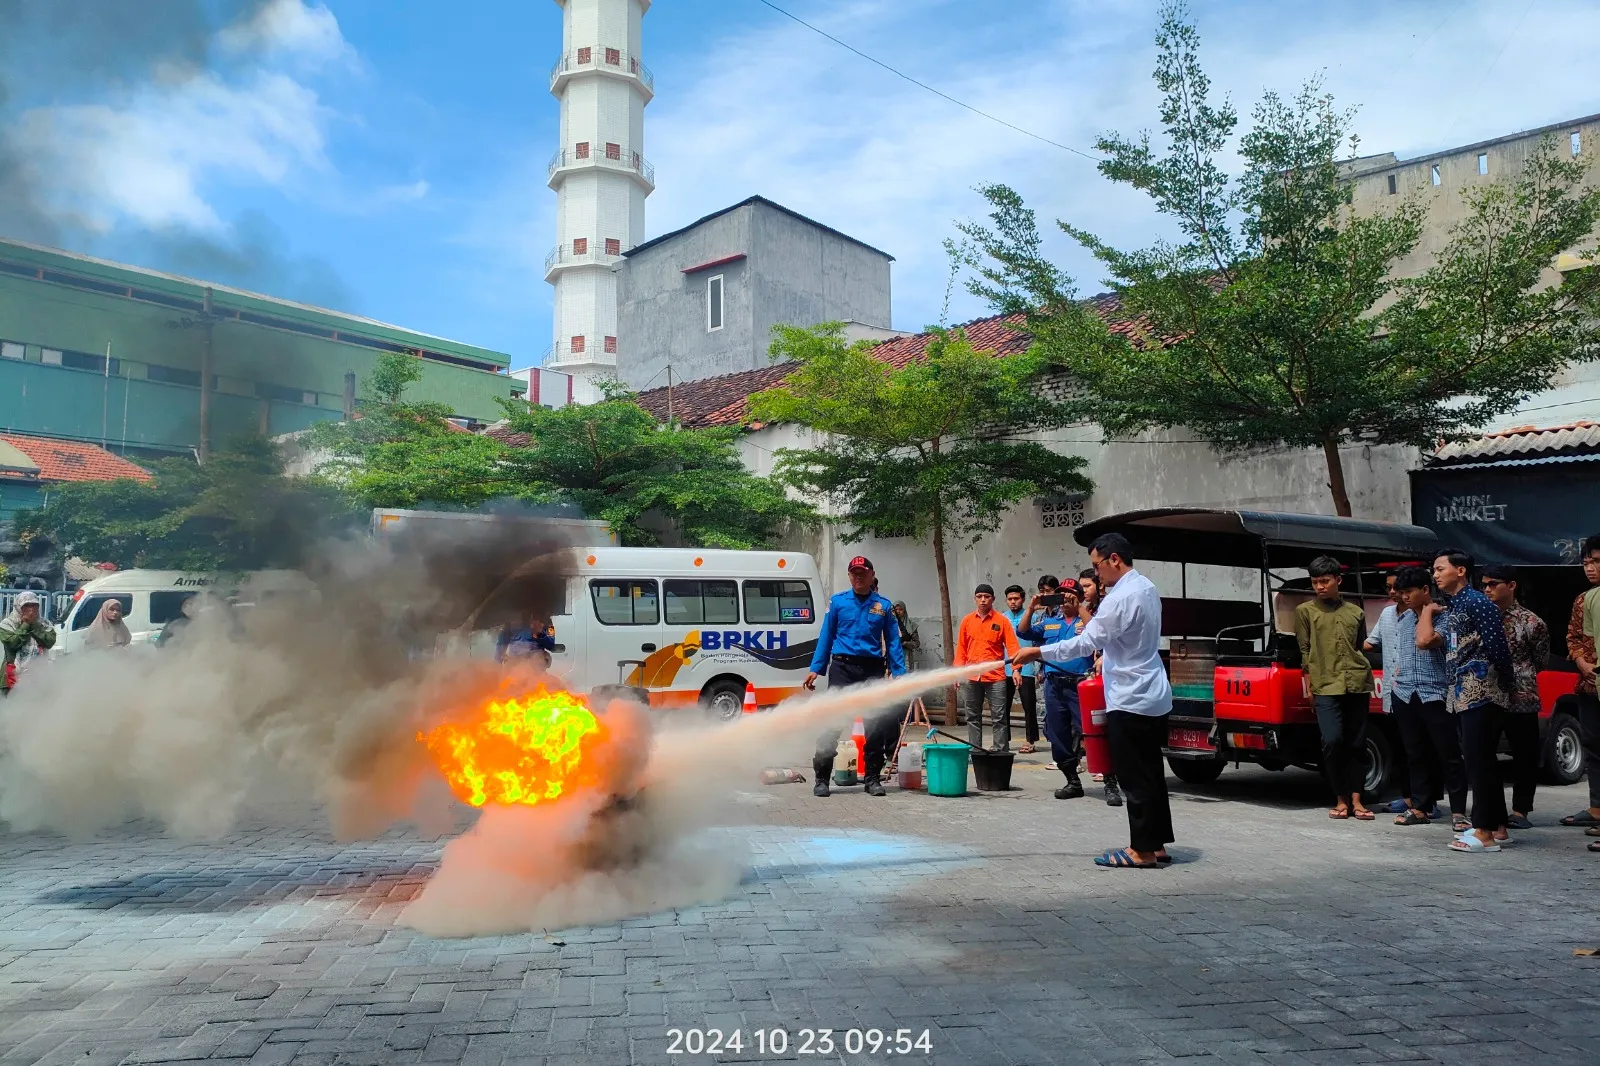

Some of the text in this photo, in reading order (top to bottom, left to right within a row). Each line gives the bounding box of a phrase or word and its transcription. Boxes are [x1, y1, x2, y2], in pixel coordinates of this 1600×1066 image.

[1435, 504, 1508, 522] MARKET
[701, 630, 788, 650] BPKH
[1225, 679, 1251, 697] 113
